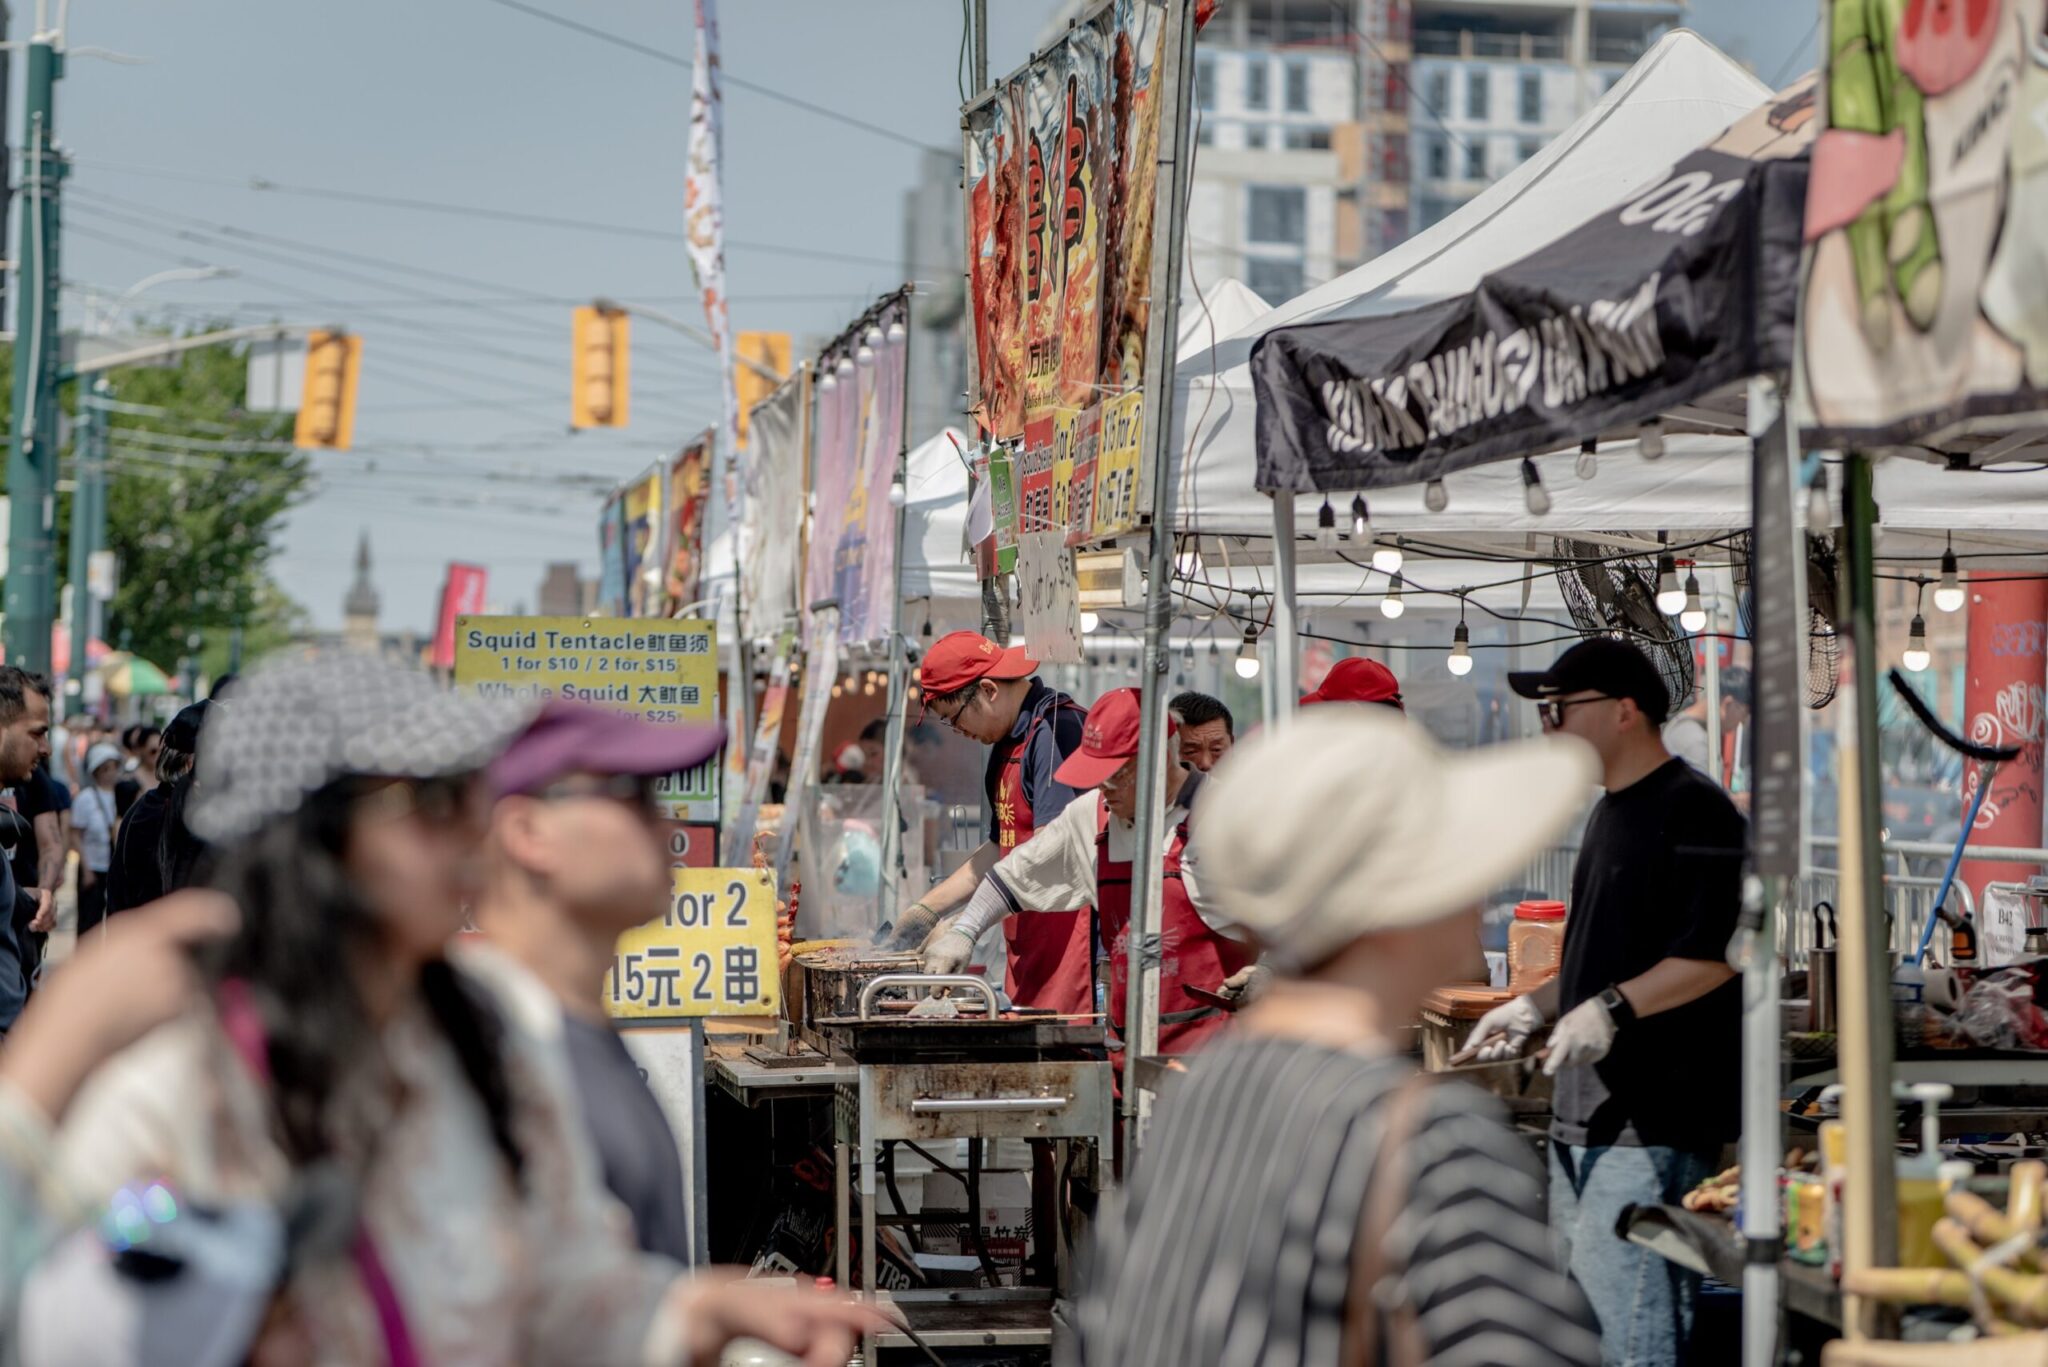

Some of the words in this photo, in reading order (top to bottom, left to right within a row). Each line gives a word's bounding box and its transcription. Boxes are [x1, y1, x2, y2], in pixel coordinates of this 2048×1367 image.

[1130, 404, 1141, 447] 2
[468, 631, 536, 652] Squid
[502, 657, 510, 670] 1
[516, 656, 541, 671] for
[548, 657, 578, 672] $10
[584, 657, 593, 673] /
[598, 657, 609, 671] 2
[615, 656, 640, 671] for
[646, 657, 677, 672] $15
[561, 683, 629, 704] Squid
[638, 685, 700, 705] 大鱿鱼
[646, 710, 677, 724] $25
[726, 881, 748, 927] 2
